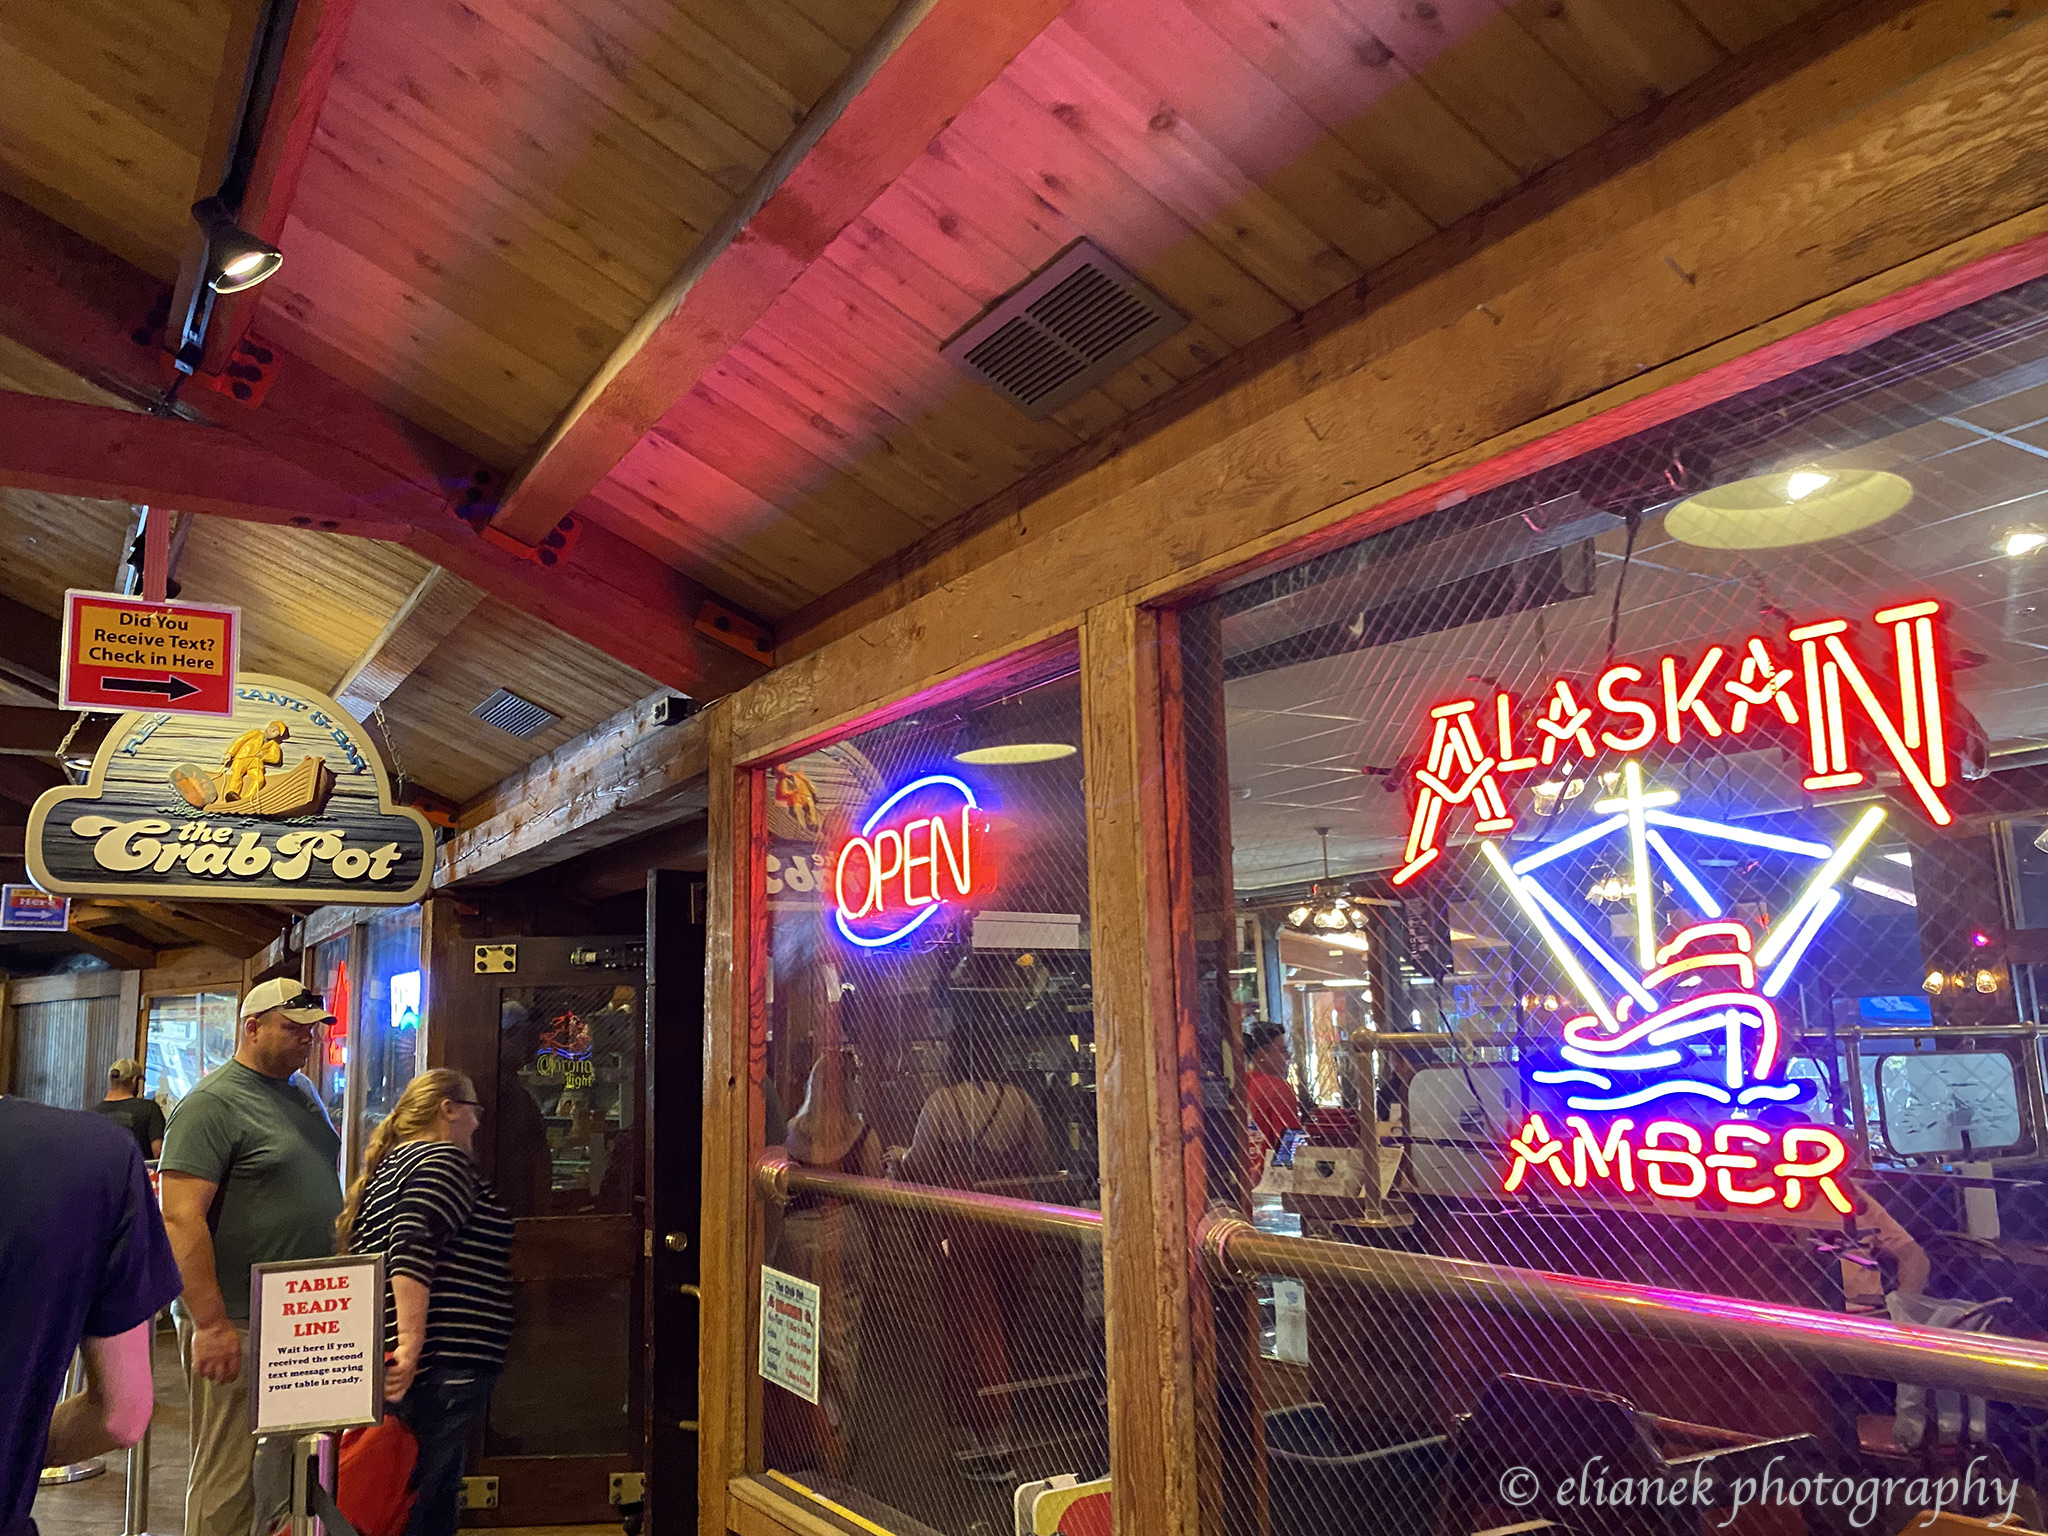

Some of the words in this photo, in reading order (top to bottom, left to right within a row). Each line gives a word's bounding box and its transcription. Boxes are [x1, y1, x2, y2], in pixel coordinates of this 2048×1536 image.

[119, 612, 151, 628] Did
[155, 616, 189, 631] You
[94, 628, 165, 647] Receive
[168, 635, 216, 651] Text?
[88, 647, 146, 664] Check
[150, 651, 168, 665] in
[172, 654, 215, 669] Here
[310, 711, 332, 729] &
[1393, 601, 1952, 885] ALASKAN
[178, 820, 233, 843] the
[71, 815, 272, 876] Crab
[271, 829, 402, 881] Pot
[836, 805, 972, 920] OPEN
[537, 1054, 594, 1078] Corona
[1503, 1114, 1853, 1214] AMBER
[285, 1276, 350, 1294] TABLE
[282, 1297, 352, 1316] READY
[294, 1320, 340, 1337] LINE
[277, 1346, 301, 1354] Wait
[302, 1345, 325, 1353] here
[336, 1342, 355, 1350] you
[268, 1357, 310, 1367] received
[312, 1355, 328, 1363] the
[330, 1352, 364, 1361] second
[268, 1371, 288, 1379] text
[290, 1368, 330, 1377] message
[332, 1364, 364, 1374] saying
[268, 1383, 292, 1392] your
[294, 1380, 319, 1388] table
[331, 1376, 363, 1385] ready.
